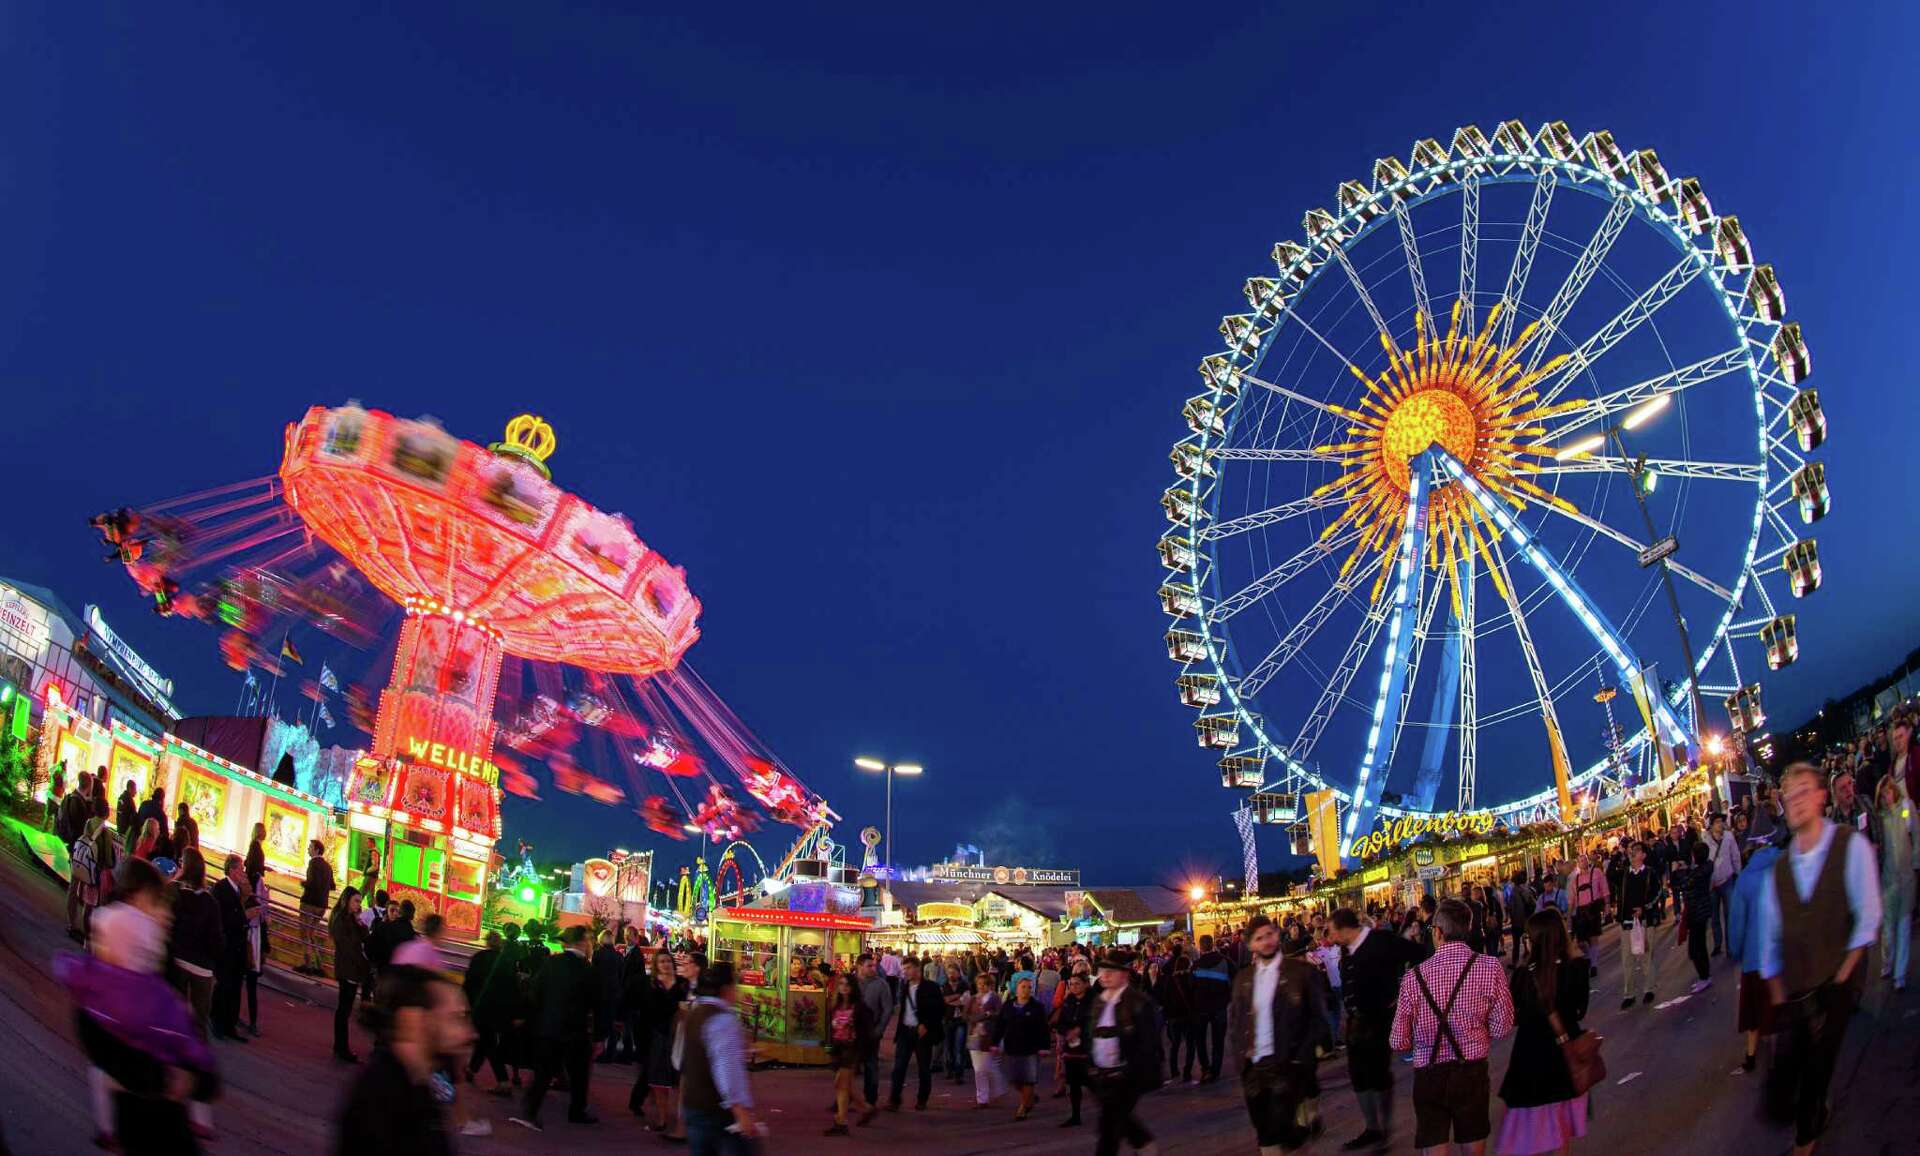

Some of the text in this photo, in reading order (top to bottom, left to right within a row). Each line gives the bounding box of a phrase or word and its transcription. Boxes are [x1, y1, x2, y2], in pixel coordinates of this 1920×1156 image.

[1350, 810, 1493, 858] Willenborg
[940, 868, 1071, 882] Münchner Knödelei
